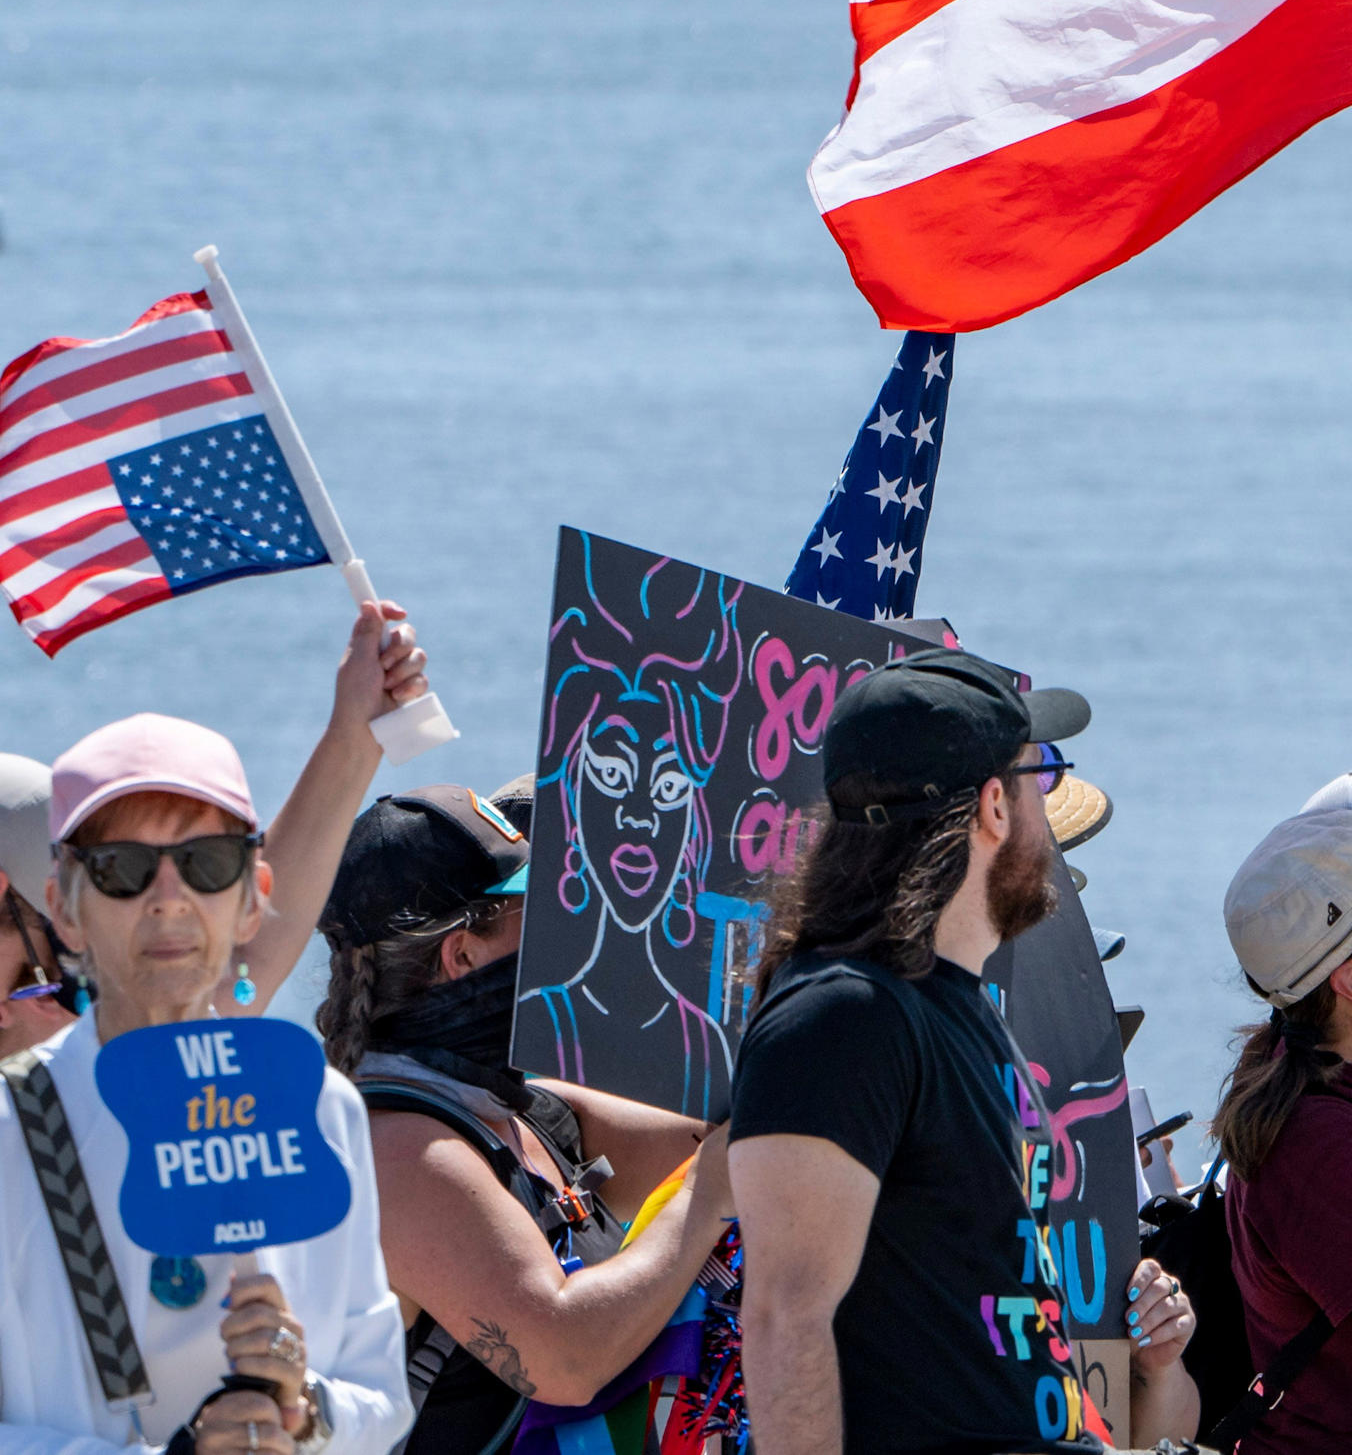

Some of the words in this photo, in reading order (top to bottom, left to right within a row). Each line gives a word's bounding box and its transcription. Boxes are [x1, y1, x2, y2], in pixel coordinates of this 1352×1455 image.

[175, 1031, 242, 1079] WE
[186, 1084, 256, 1132] the
[154, 1128, 306, 1189] PEOPLE
[214, 1219, 266, 1244] ACLU
[980, 1295, 1072, 1362] IT'S
